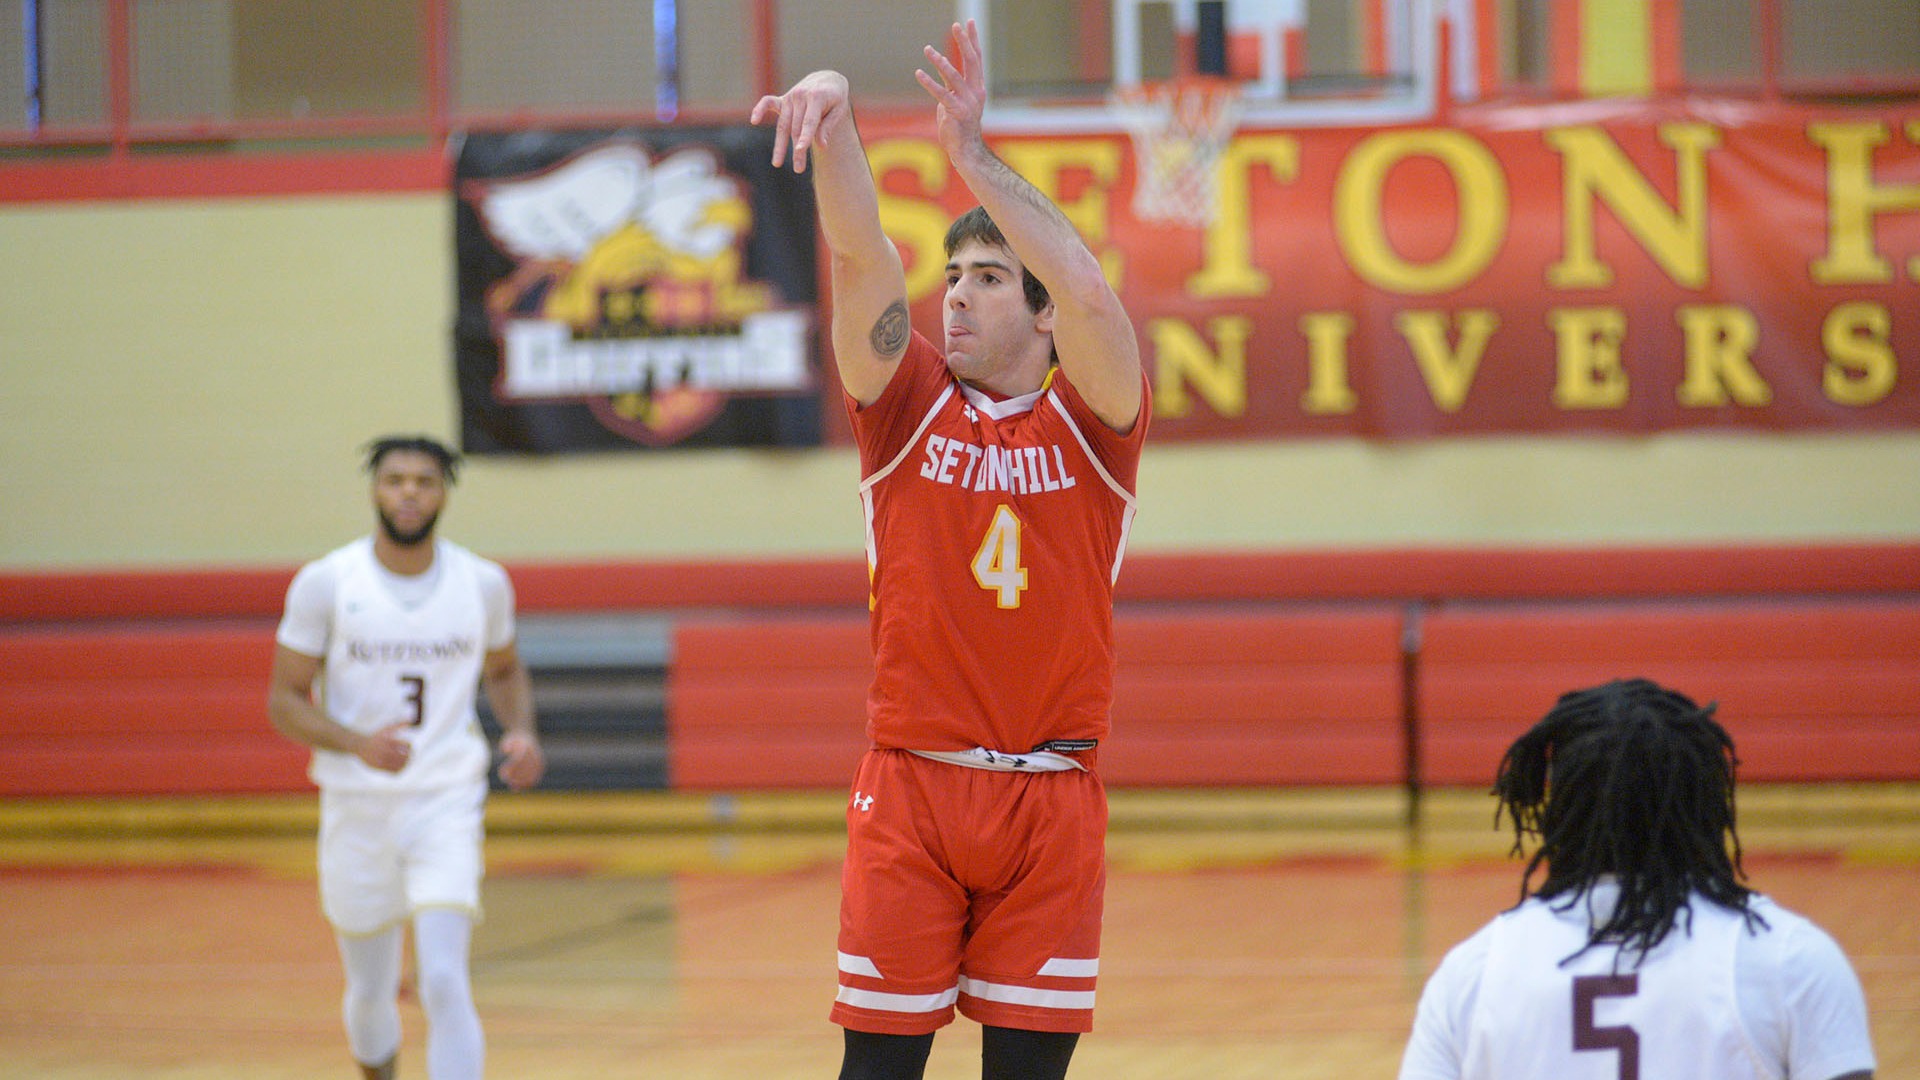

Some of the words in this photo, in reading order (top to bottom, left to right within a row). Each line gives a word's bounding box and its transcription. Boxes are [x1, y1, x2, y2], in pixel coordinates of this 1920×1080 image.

[1149, 302, 1899, 416] NIVERS
[970, 503, 1028, 609] 4
[400, 674, 425, 727] 3
[1572, 973, 1640, 1080] 5
